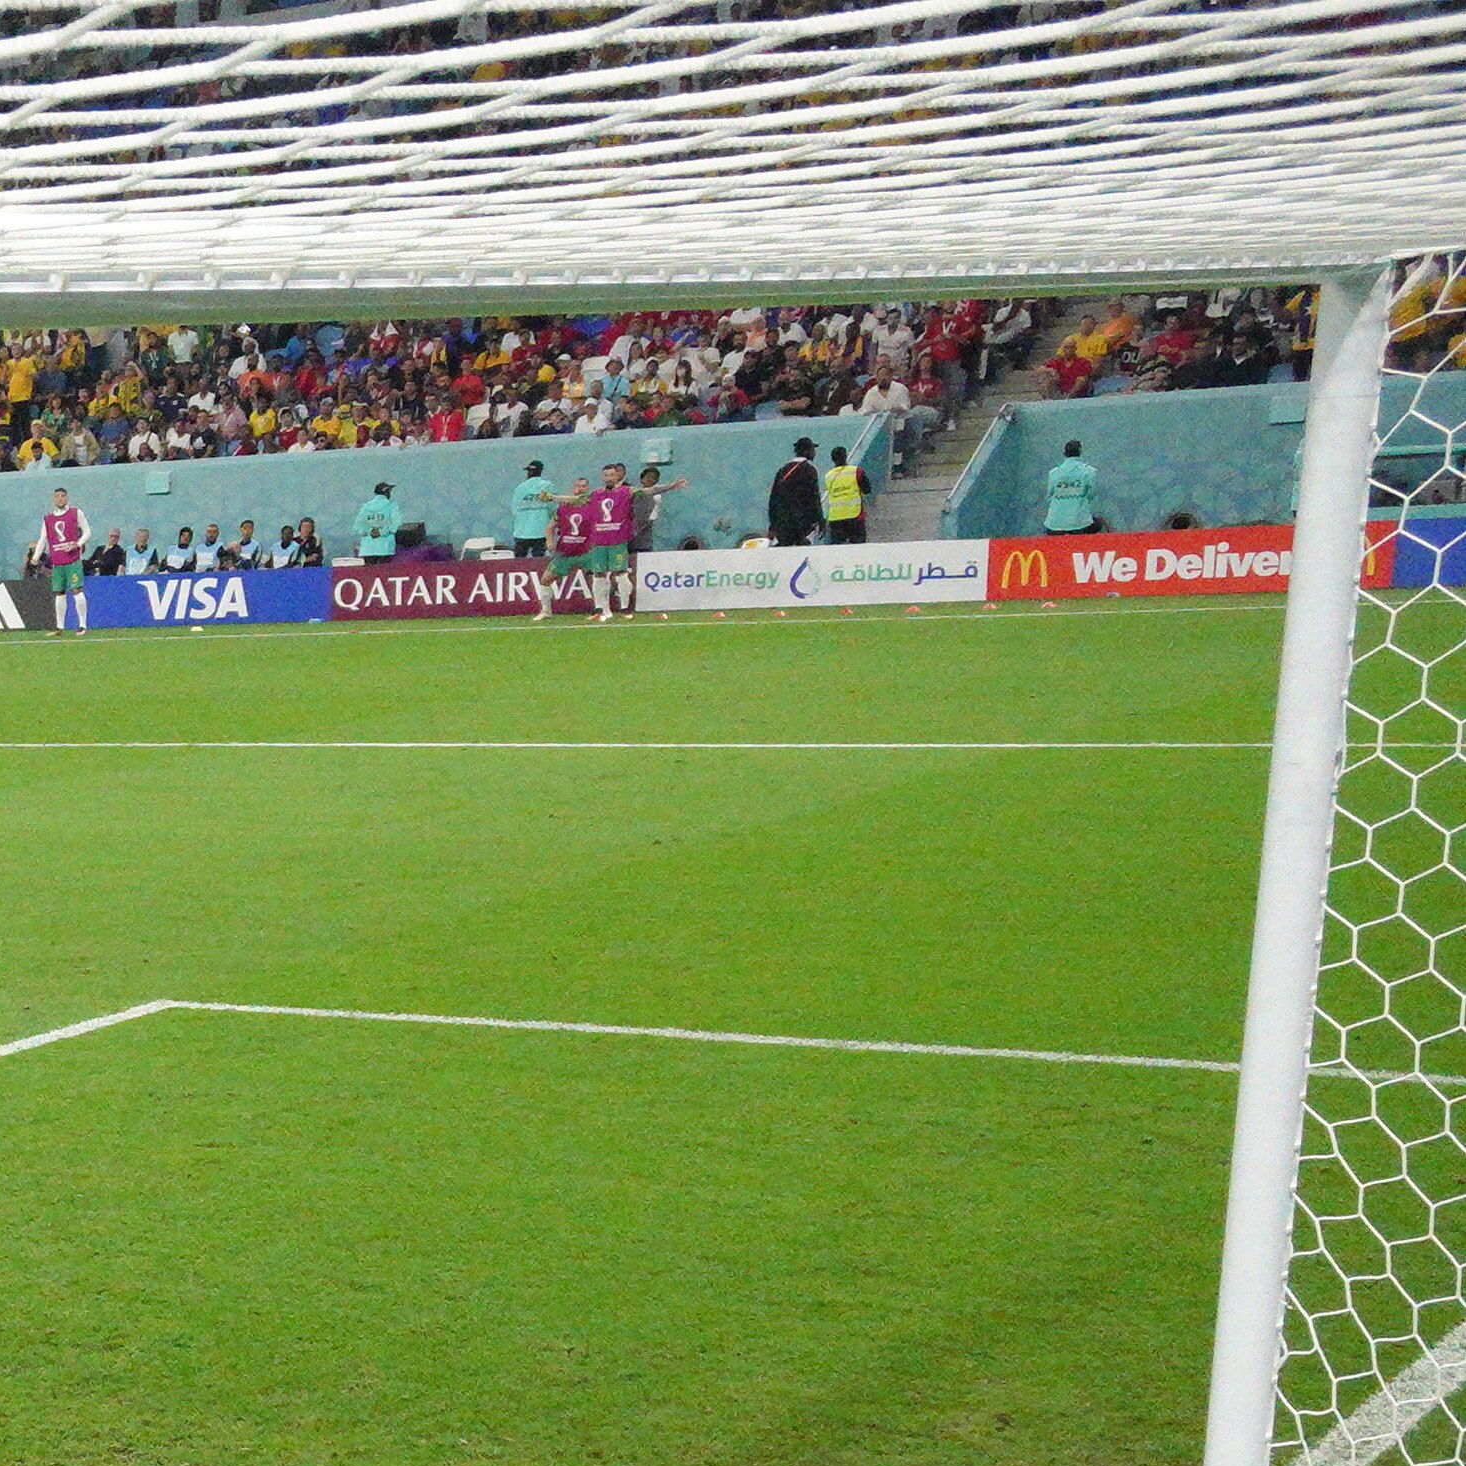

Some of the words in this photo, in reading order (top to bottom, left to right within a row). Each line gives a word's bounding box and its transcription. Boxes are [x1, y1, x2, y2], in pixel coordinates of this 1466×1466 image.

[644, 569, 780, 592] QatarEnergy
[1072, 551, 1138, 584] We
[1144, 541, 1292, 581] Deliver
[137, 576, 249, 621] VISA
[334, 574, 457, 611] QATAR
[468, 568, 593, 603] AIRWA
